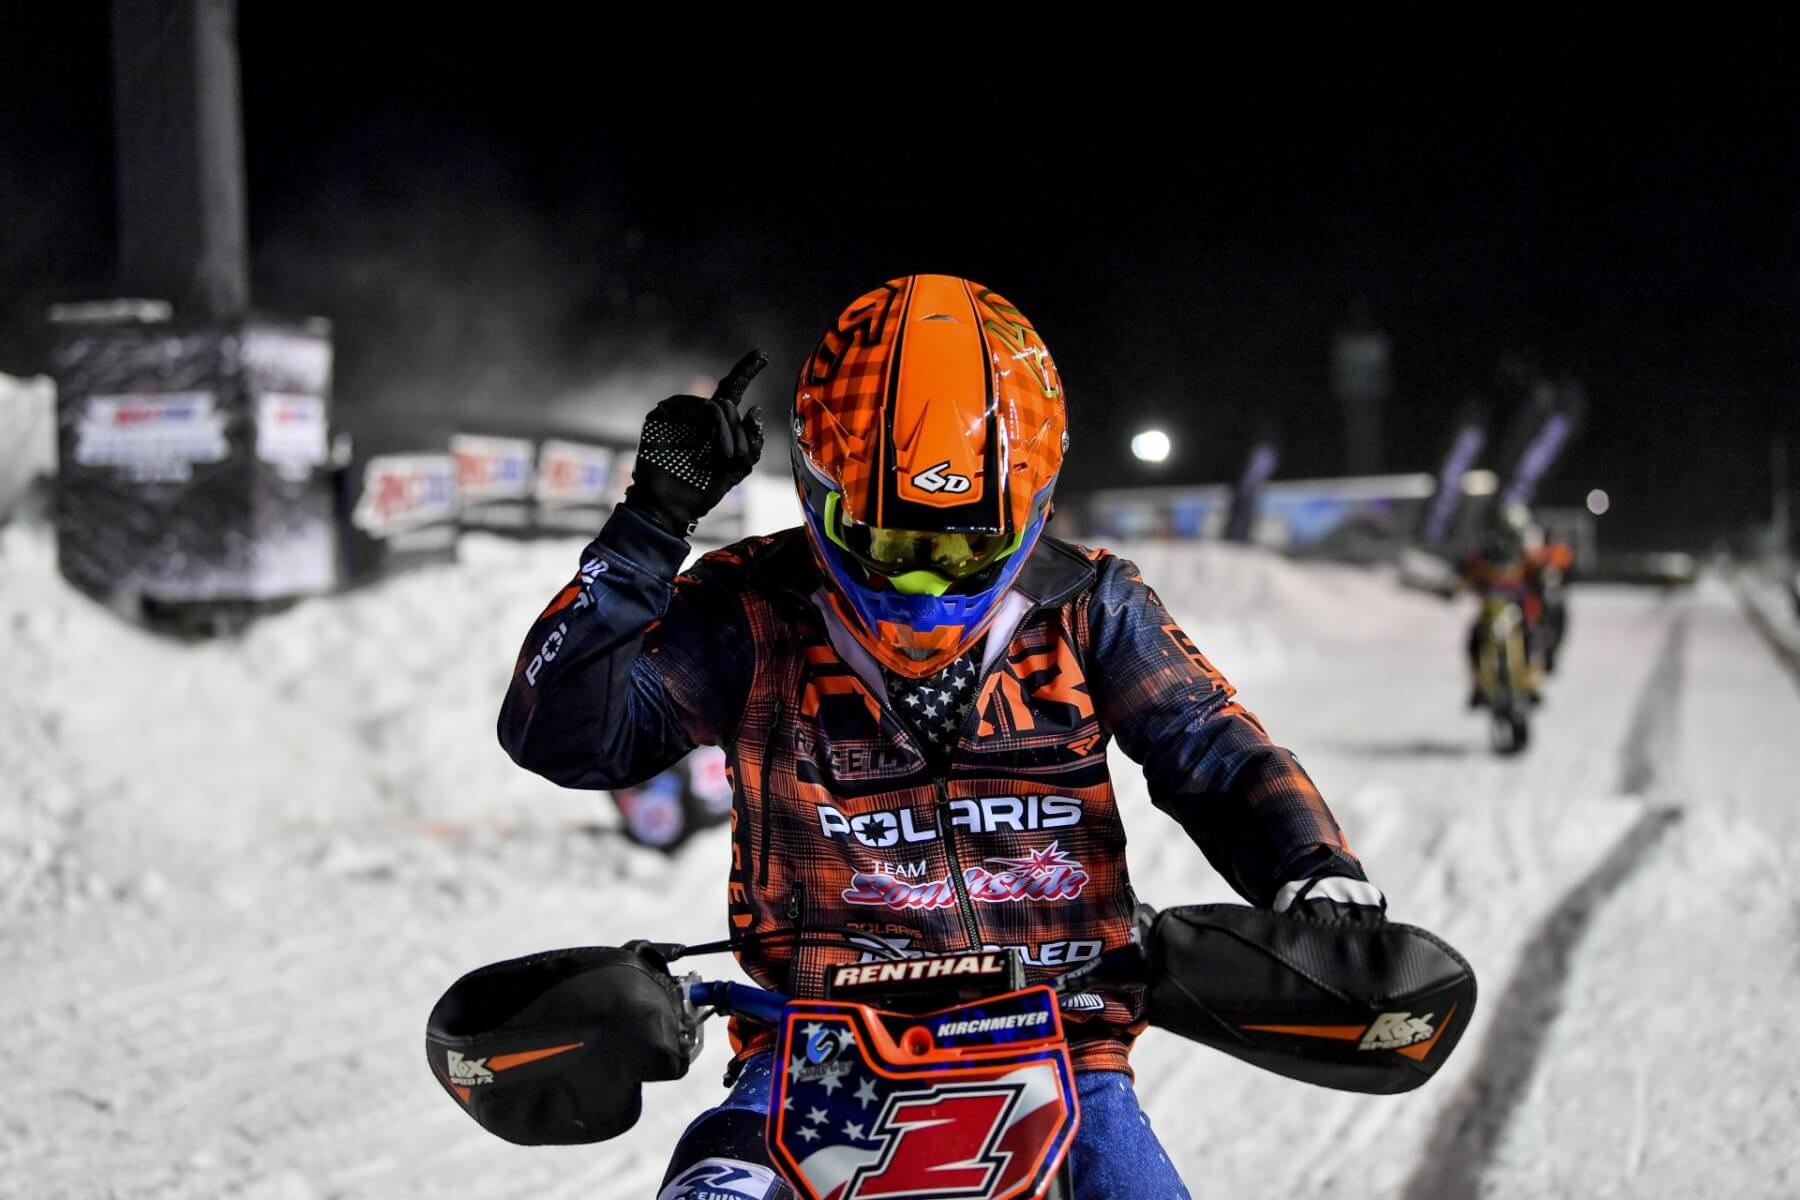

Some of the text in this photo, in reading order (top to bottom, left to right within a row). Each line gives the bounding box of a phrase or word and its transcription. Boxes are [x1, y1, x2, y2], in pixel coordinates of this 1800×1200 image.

[912, 461, 971, 493] 6D
[525, 557, 609, 688] POIS
[817, 795, 1084, 849] POLARIS
[872, 860, 927, 878] TEAM
[833, 954, 1004, 987] RENTHAL
[938, 1011, 1049, 1037] KIRCHMEYER
[841, 1083, 1027, 1200] 1
